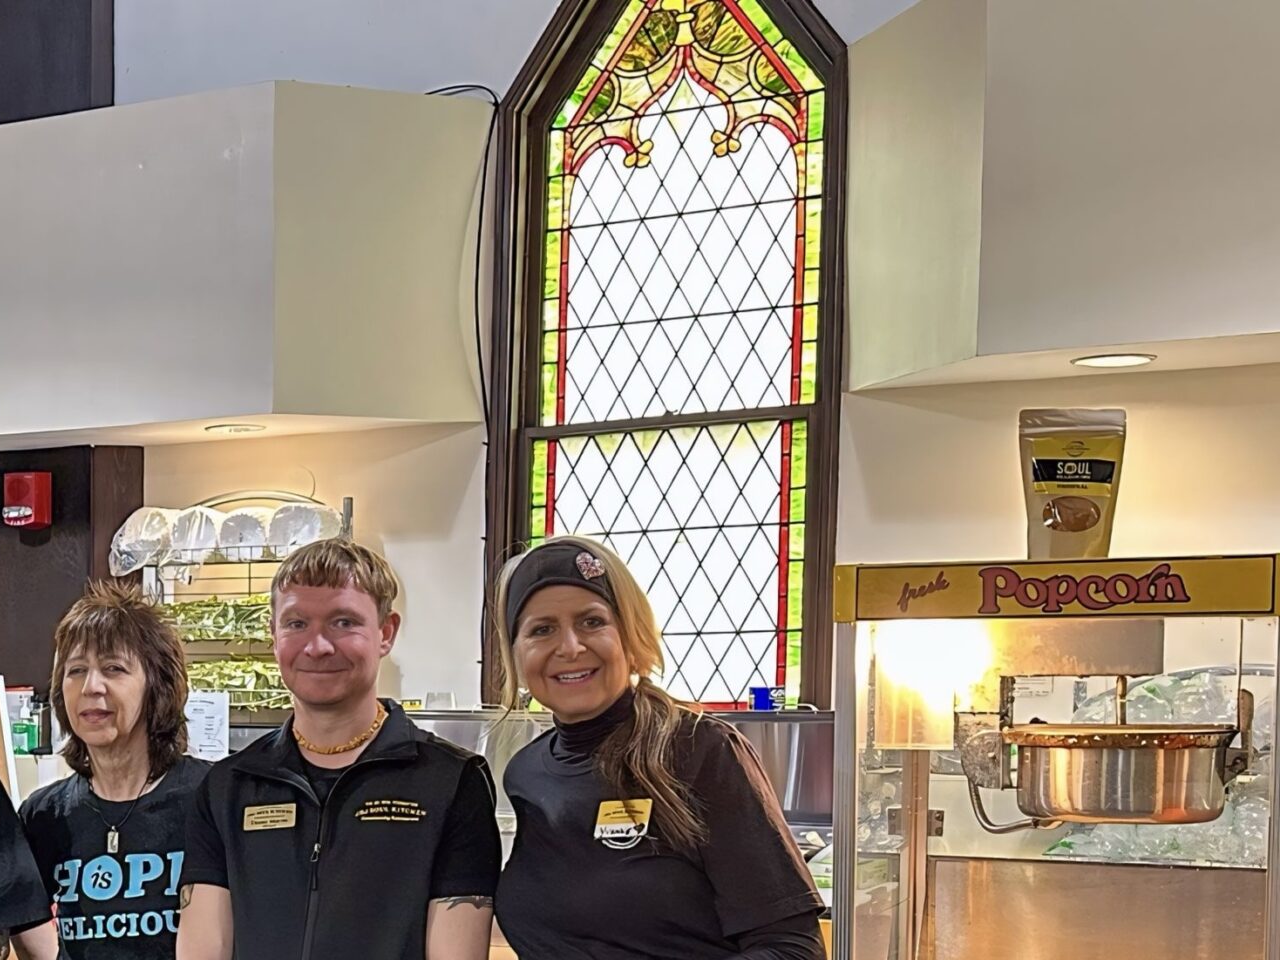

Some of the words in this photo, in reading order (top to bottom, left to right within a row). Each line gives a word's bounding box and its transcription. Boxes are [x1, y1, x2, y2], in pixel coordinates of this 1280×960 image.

[1056, 462, 1091, 475] SOUL
[897, 571, 950, 612] fresh
[977, 563, 1191, 614] Popcorn
[91, 864, 113, 889] is
[57, 909, 181, 940] ELICIOU
